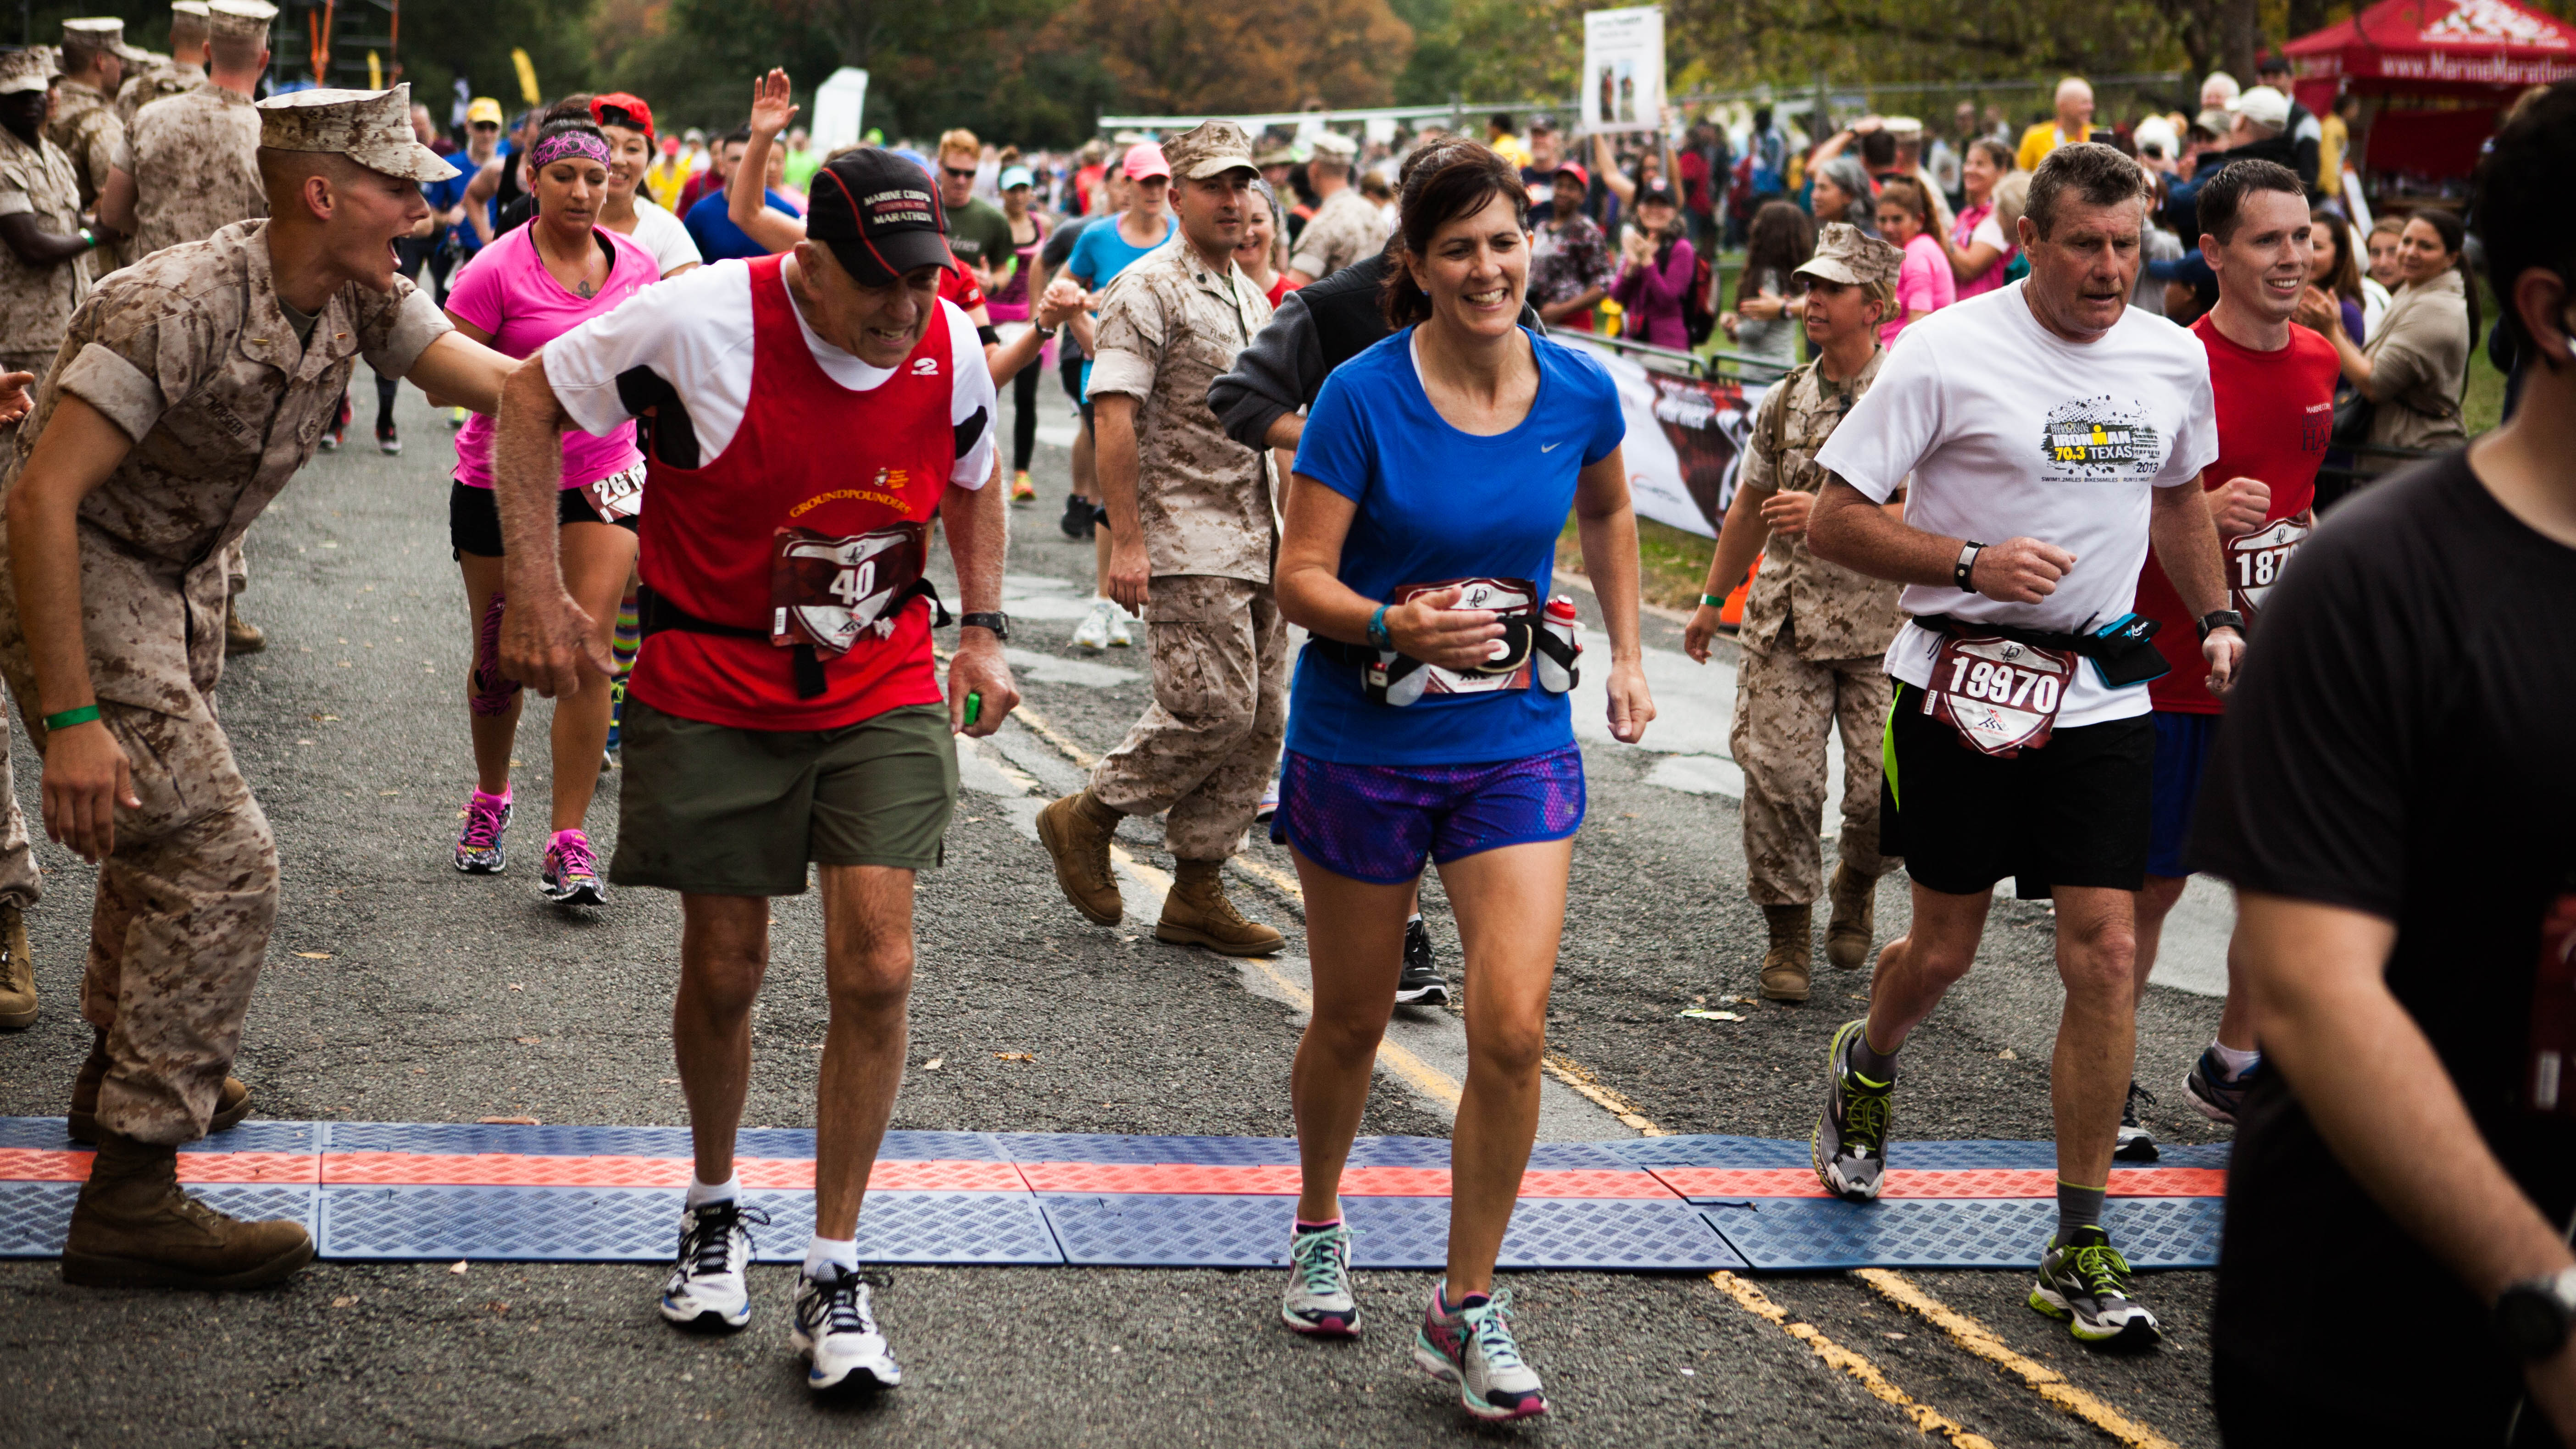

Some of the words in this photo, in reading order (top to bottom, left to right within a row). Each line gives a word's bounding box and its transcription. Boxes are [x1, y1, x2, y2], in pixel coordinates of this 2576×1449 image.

[863, 190, 903, 206] MARINE
[903, 190, 931, 202] CORPS
[873, 211, 933, 225] MARATHON
[2050, 422, 2088, 432] MEMORIAL
[2051, 426, 2089, 434] HERMANN
[2052, 424, 2131, 447] IRONMAN
[2054, 446, 2086, 461] 70.3
[2088, 445, 2133, 459] TEXAS
[2136, 462, 2159, 473] 2013
[829, 560, 875, 605] 40
[1949, 656, 2060, 714] 19970
